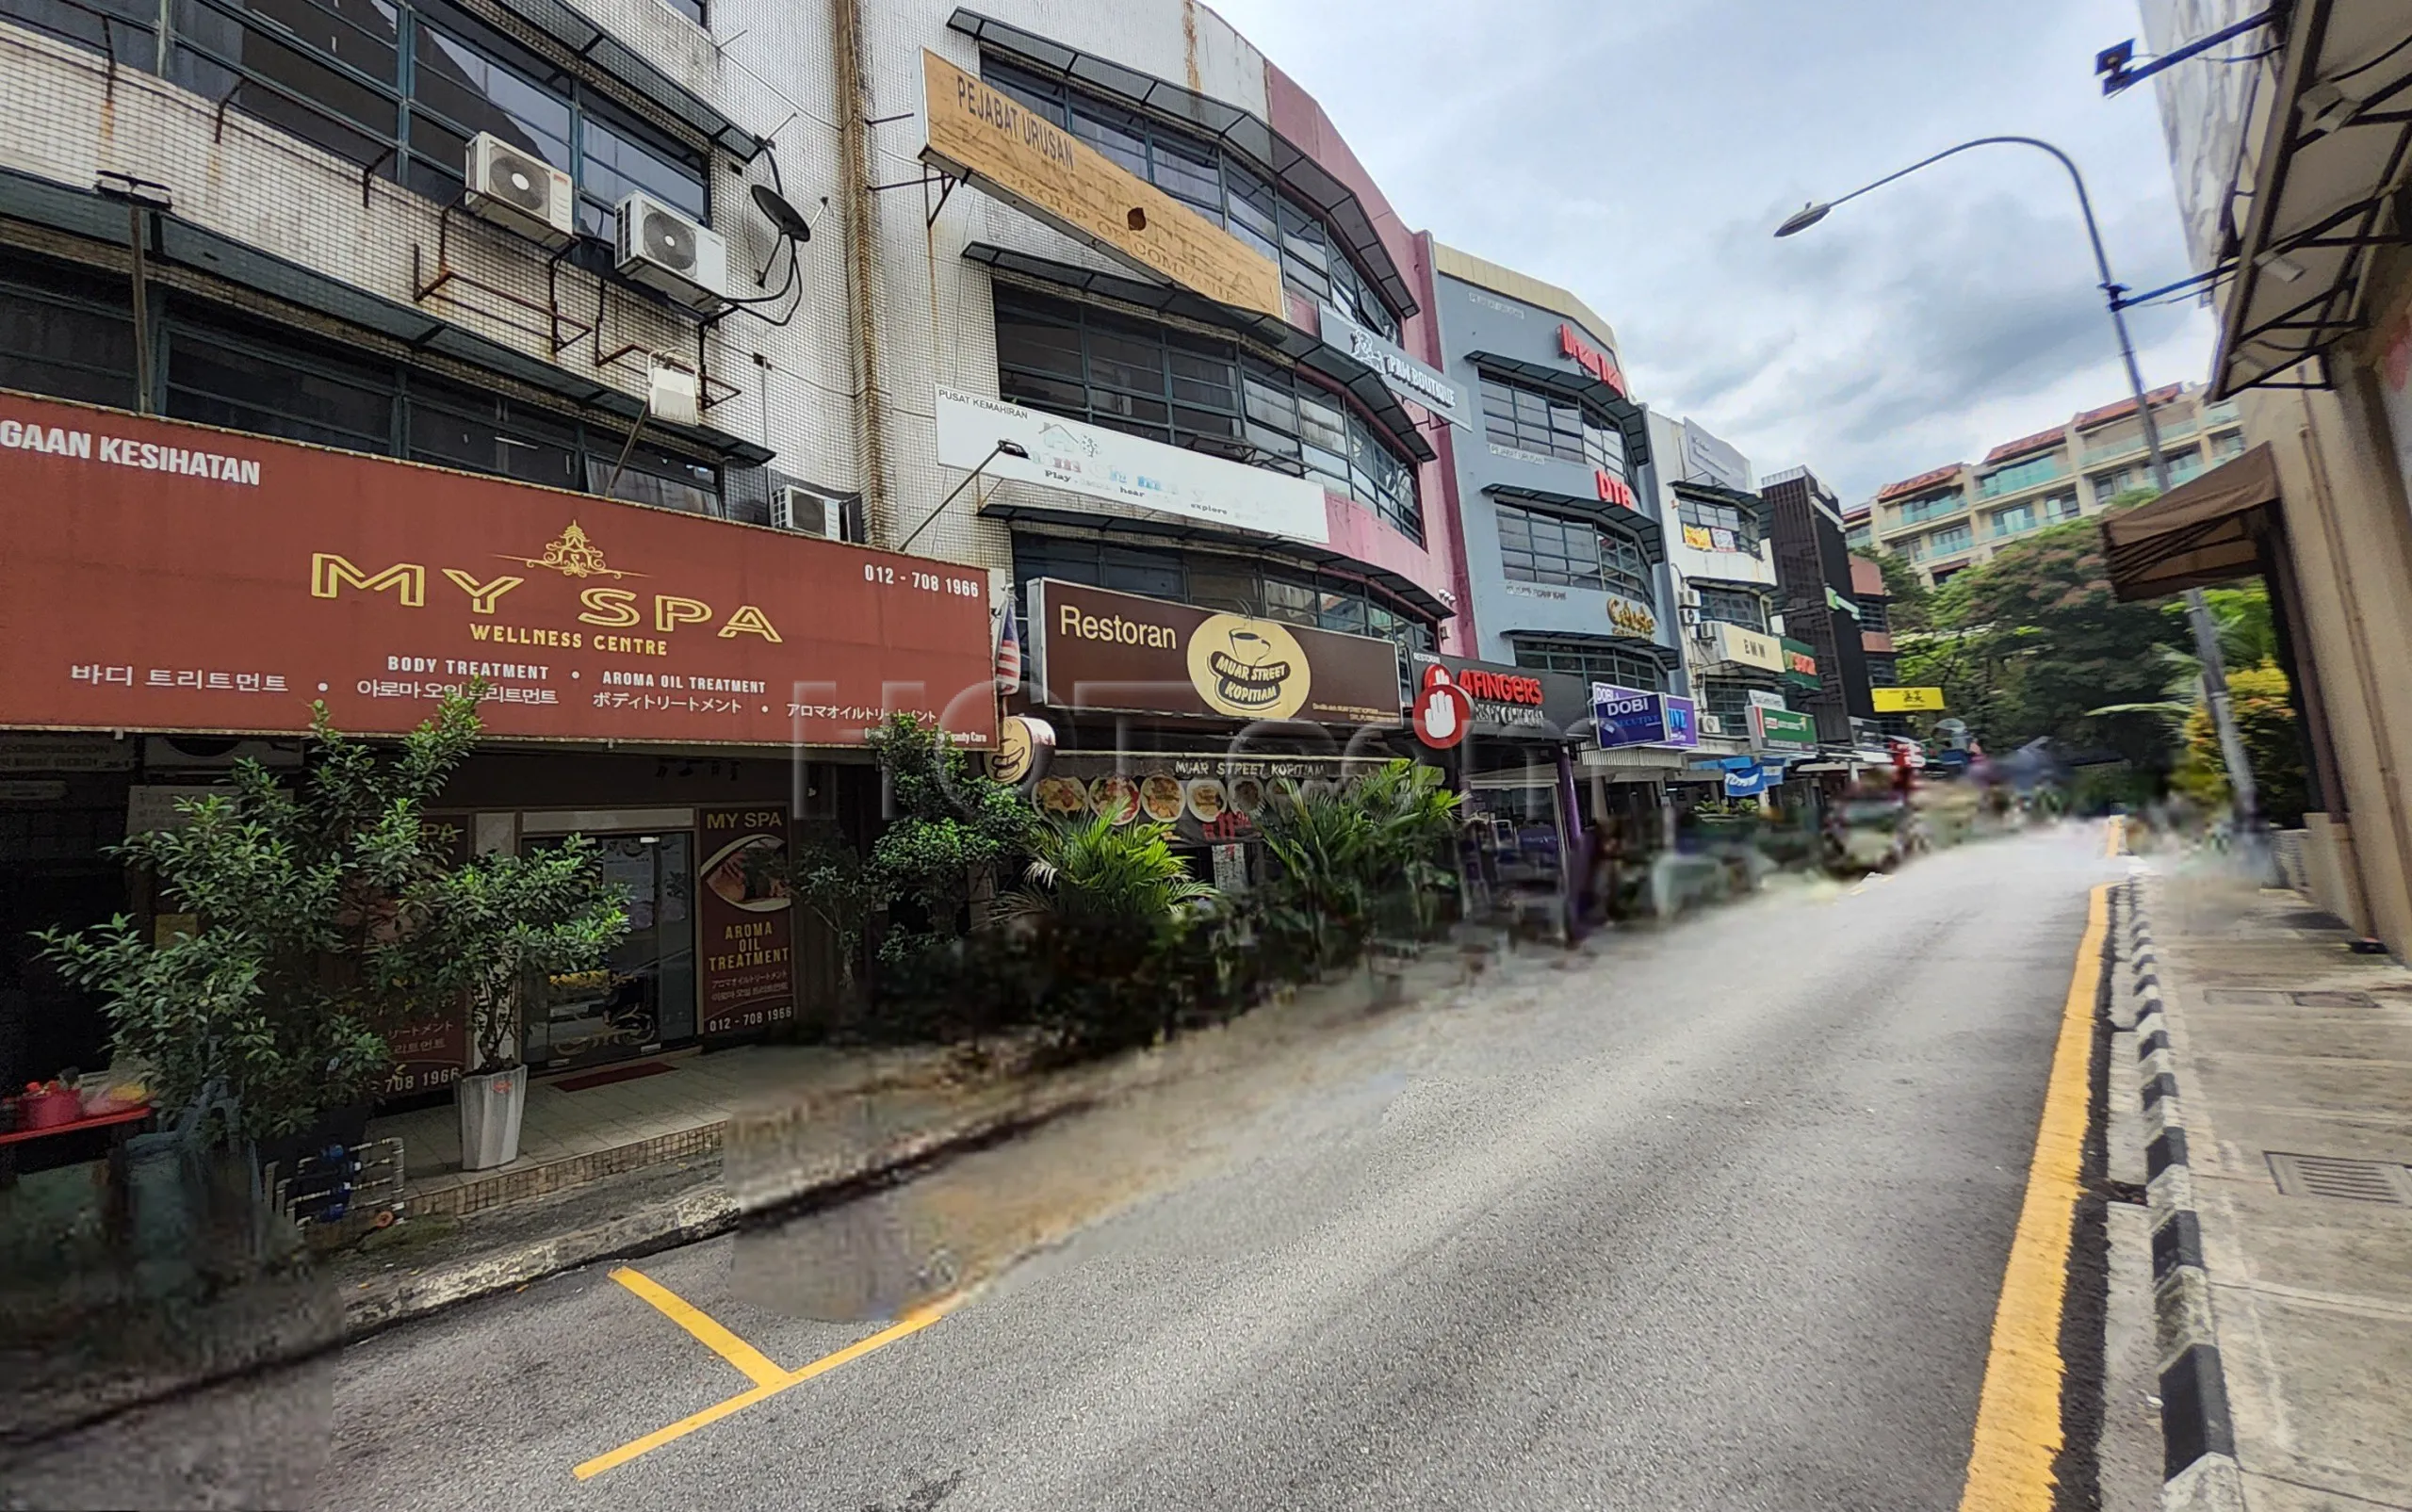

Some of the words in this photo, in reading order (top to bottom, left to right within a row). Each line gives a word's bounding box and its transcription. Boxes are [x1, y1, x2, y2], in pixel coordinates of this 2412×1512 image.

[956, 74, 1019, 139] PEJABAT
[1021, 116, 1075, 171] URUSAN
[1387, 352, 1411, 382] PAW
[1411, 367, 1457, 407] BOUTIQUE
[938, 389, 971, 408] PUSAT
[972, 397, 1029, 421] KEMAHIRAN
[99, 436, 260, 485] KESIHATAN
[1044, 469, 1072, 483] Play
[863, 564, 895, 586] 012
[911, 571, 940, 593] 708
[944, 577, 980, 599] 1966
[311, 551, 525, 614] MY
[578, 587, 784, 643] SPA
[1058, 604, 1177, 650] Restoran
[469, 623, 583, 650] WELLNESS
[593, 634, 668, 657] CENTRE
[71, 663, 134, 687] 바디
[144, 668, 289, 693] 트리트먼트
[387, 656, 437, 674] BODY
[445, 659, 550, 680] TREATMENT
[1215, 655, 1249, 681] MUAR
[1250, 664, 1287, 682] STREET
[356, 678, 419, 699] 아로마
[601, 670, 655, 688] AROMA
[660, 675, 684, 691] OIL
[689, 677, 767, 694] TREATMENT
[1224, 681, 1278, 703] KOPITIAM
[592, 691, 742, 715] ボディトリートメント
[1606, 698, 1650, 717] DOBI
[1175, 760, 1210, 775] MUAR
[1215, 761, 1265, 775] STREET
[707, 813, 739, 829] MY
[743, 811, 783, 828] SPA
[725, 920, 773, 940] AROMA
[739, 937, 761, 952] OIL
[709, 948, 789, 972] TREATMENT
[709, 1017, 732, 1032] 012
[742, 1011, 764, 1026] 708
[767, 1005, 792, 1022] 1966
[383, 1073, 416, 1094] 708
